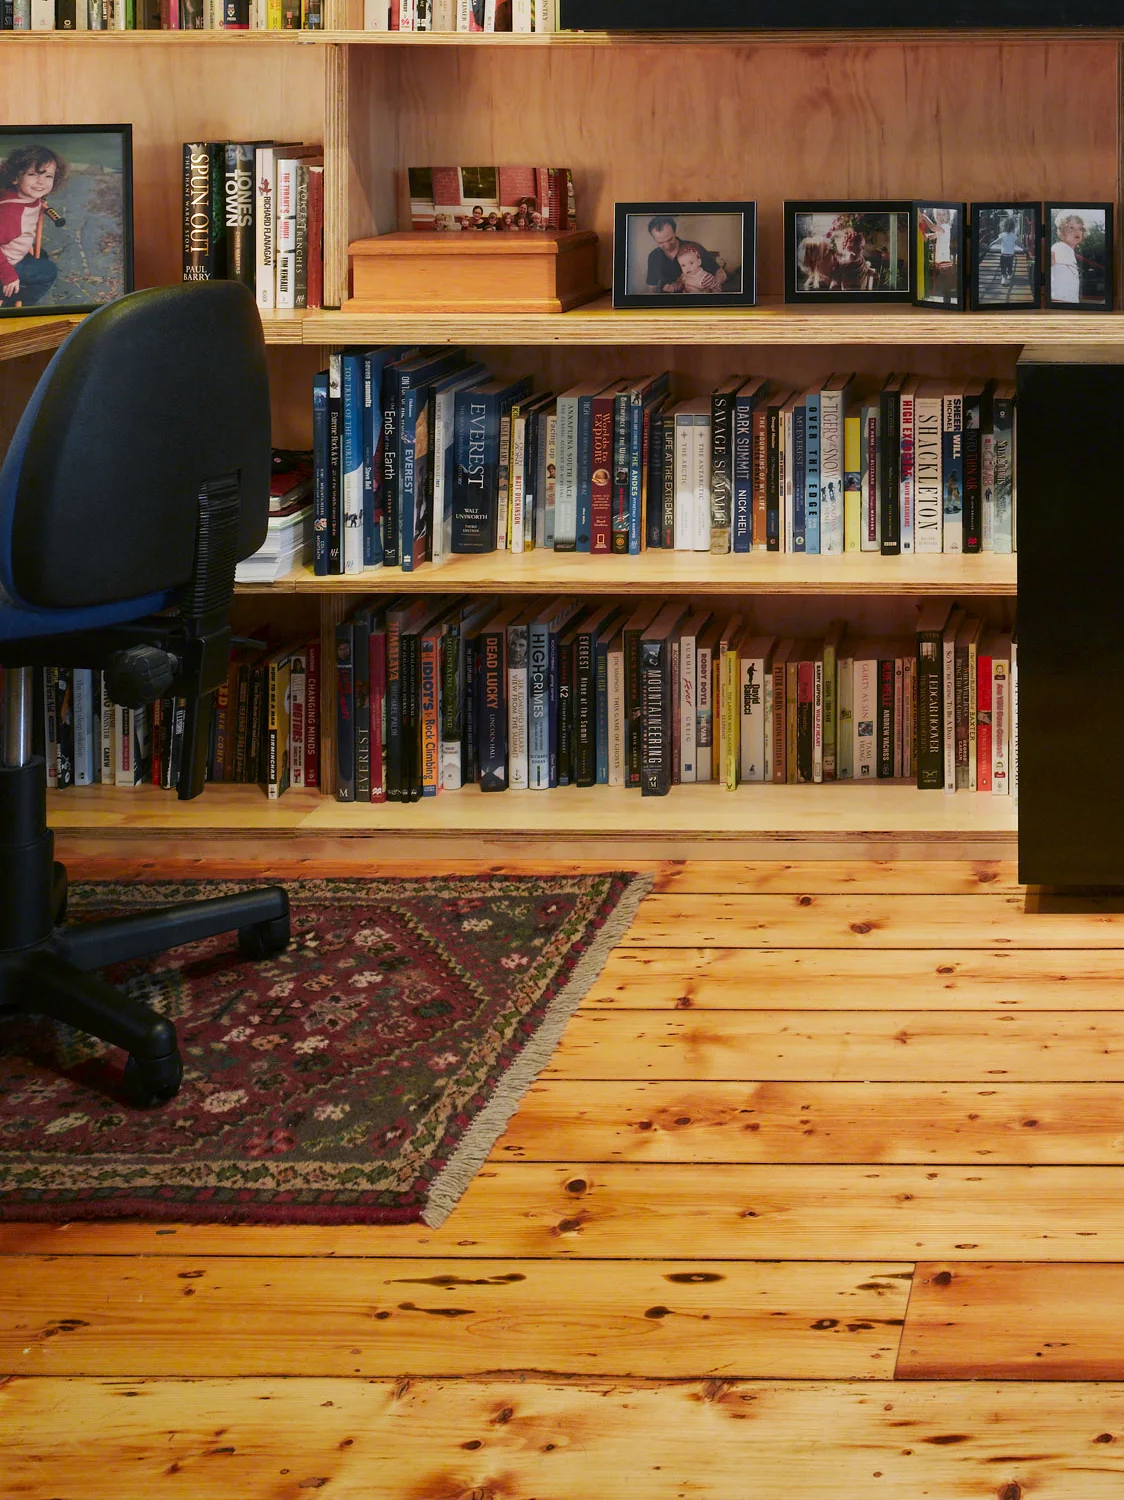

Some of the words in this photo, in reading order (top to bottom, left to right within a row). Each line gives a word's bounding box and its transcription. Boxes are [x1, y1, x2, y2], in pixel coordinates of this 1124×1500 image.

[190, 153, 210, 207] SPUN
[225, 169, 238, 227] TOWN
[237, 171, 252, 227] JONES
[190, 212, 210, 257] OUT
[264, 228, 272, 266] FLANAGAN
[296, 222, 307, 274] TRENCHES
[183, 273, 211, 282] BARRY
[185, 264, 208, 273] PAUL
[344, 366, 352, 381] TOP
[344, 384, 352, 407] TREKS
[344, 410, 352, 419] OF
[384, 410, 395, 435] Ends
[714, 398, 726, 455] SAVAGE
[737, 406, 749, 434] DARK
[808, 406, 817, 439] OVER
[902, 400, 912, 423] HIGH
[953, 398, 961, 432] SHEER
[468, 403, 486, 489] EVEREST
[602, 412, 611, 449] Worlds
[664, 431, 673, 449] LIFE
[602, 451, 609, 463] to
[631, 451, 639, 467] THE
[664, 453, 673, 462] AT
[737, 438, 749, 480] SUMMIT
[808, 450, 817, 473] THE
[902, 427, 912, 477] EXPOSURE
[953, 434, 961, 460] WILL
[384, 451, 396, 480] Earth
[404, 449, 413, 494] EVEREST
[664, 464, 673, 480] THE
[823, 448, 839, 481] SNOW
[918, 415, 939, 530] SHACKLETON
[966, 453, 977, 474] THIN
[631, 469, 639, 496] ANDES
[714, 460, 727, 525] SUMMIT
[966, 477, 977, 491] AIR
[664, 482, 673, 526] EXTREMES
[738, 489, 746, 512] NICK
[808, 484, 817, 517] EDGE
[738, 515, 746, 536] HEIL
[388, 621, 400, 681] HIMALAYA
[486, 637, 498, 668] DEAD
[579, 636, 588, 669] EVEREST
[308, 678, 316, 722] CHANGING
[423, 661, 434, 711] IDIOT'S
[486, 672, 498, 709] LUCKY
[560, 685, 569, 698] K2
[682, 677, 693, 707] Fever
[744, 684, 753, 716] Baldacci
[752, 684, 761, 704] David
[425, 719, 436, 739] Rock
[648, 669, 662, 764] MOUNTAINEERING
[308, 726, 316, 755] MINDS
[613, 733, 619, 742] OF
[358, 728, 369, 793] EVEREST
[422, 742, 435, 780] Climbing
